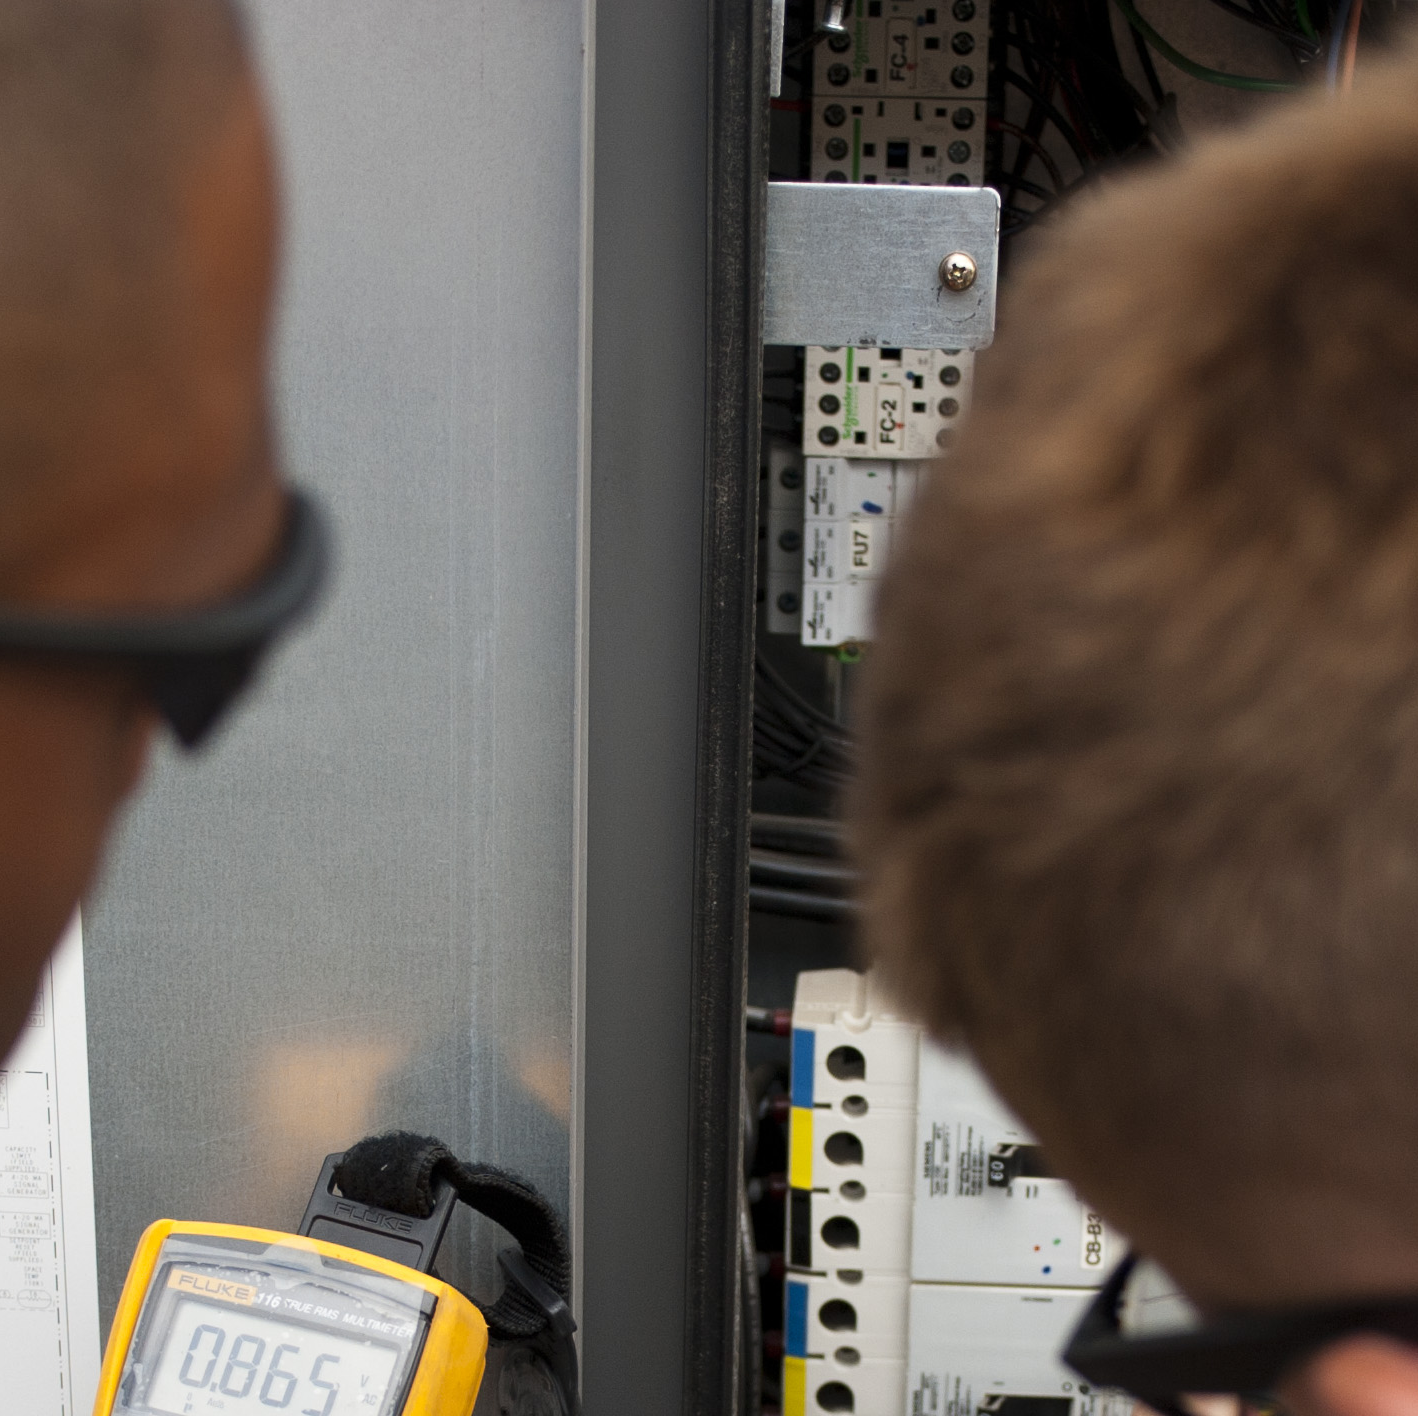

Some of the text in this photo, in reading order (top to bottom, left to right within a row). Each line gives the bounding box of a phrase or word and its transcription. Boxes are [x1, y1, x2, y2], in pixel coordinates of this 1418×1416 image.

[889, 34, 909, 82] FC-4
[880, 399, 897, 444] FC-2
[853, 530, 869, 567] FU7
[990, 1161, 1005, 1181] 60
[333, 1203, 414, 1234] FLUKE
[1085, 1212, 1102, 1266] CB-B3
[177, 1275, 251, 1300] FLUKE
[257, 1292, 415, 1338] 116 TRUE RMS MULTIMETER
[360, 1374, 370, 1387] V
[362, 1393, 378, 1406] AC
